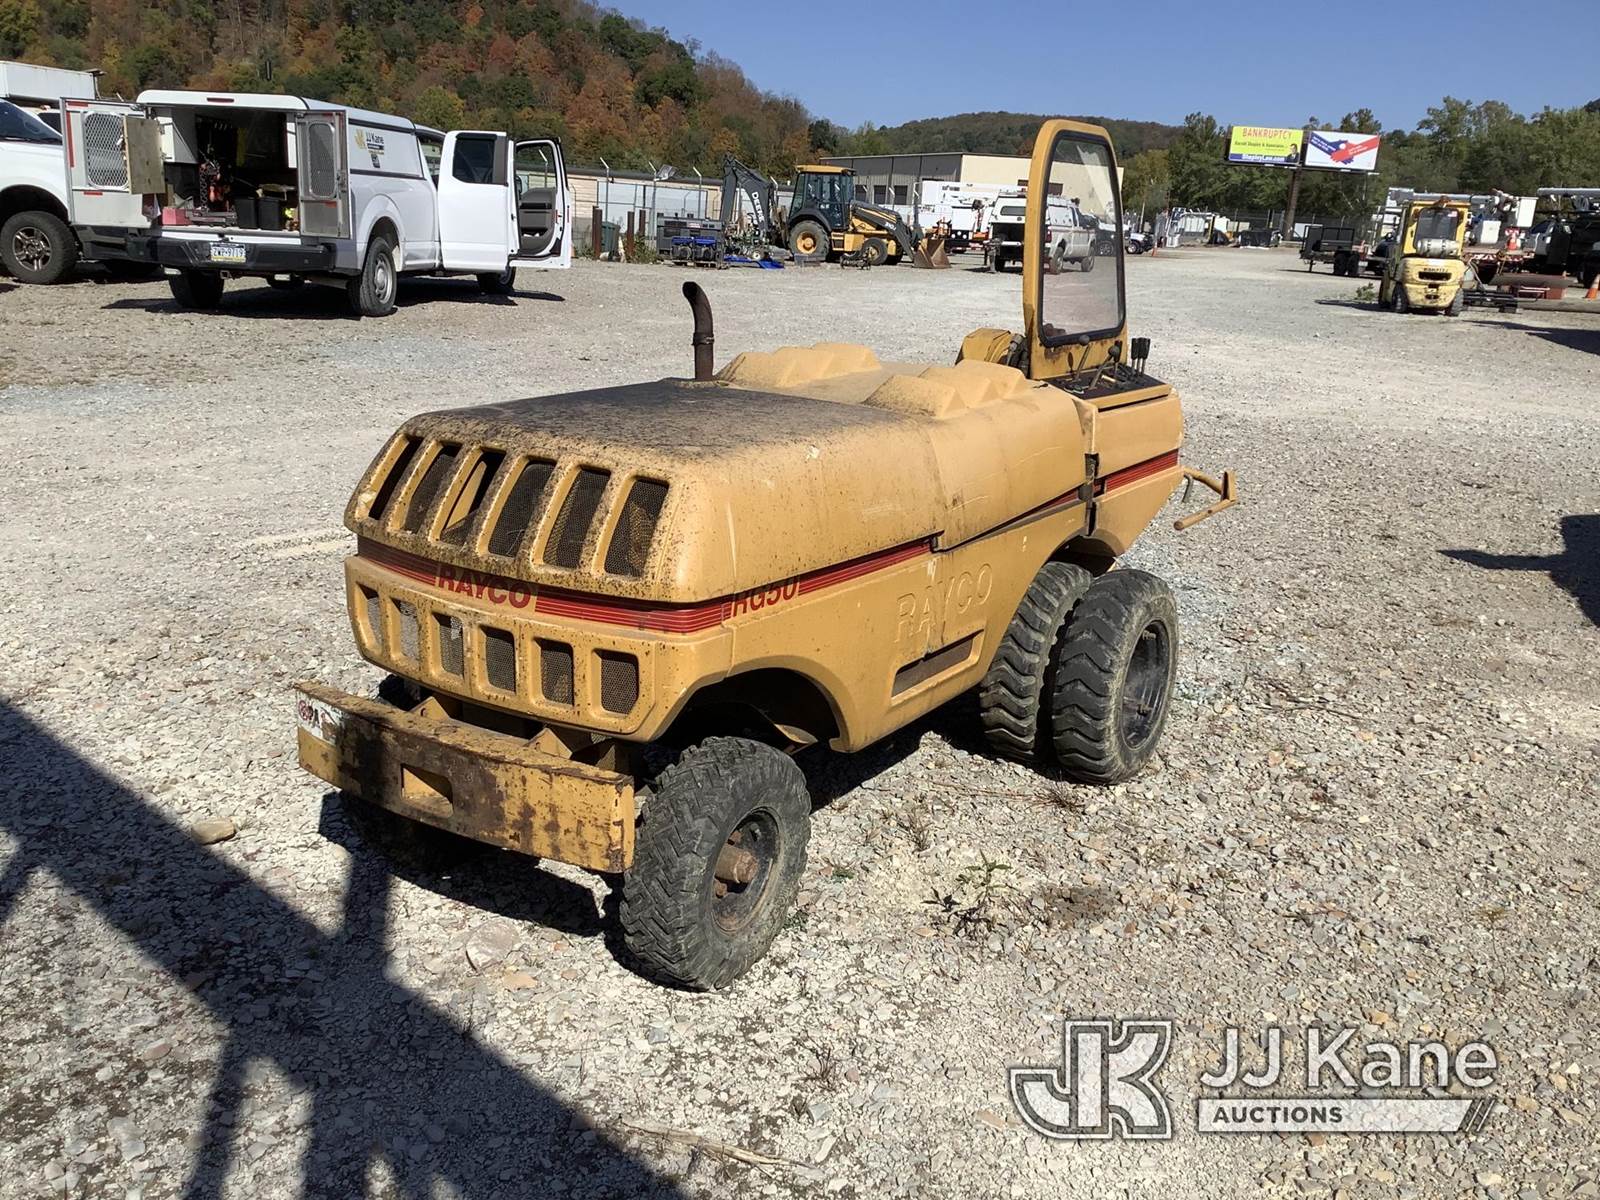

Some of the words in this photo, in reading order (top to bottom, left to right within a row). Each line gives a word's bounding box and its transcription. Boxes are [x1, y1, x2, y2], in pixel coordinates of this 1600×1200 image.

[1242, 127, 1292, 139] BANKRUPTCY
[437, 565, 531, 609] RAYCO
[732, 575, 799, 617] HG50
[894, 563, 993, 648] RAYCO
